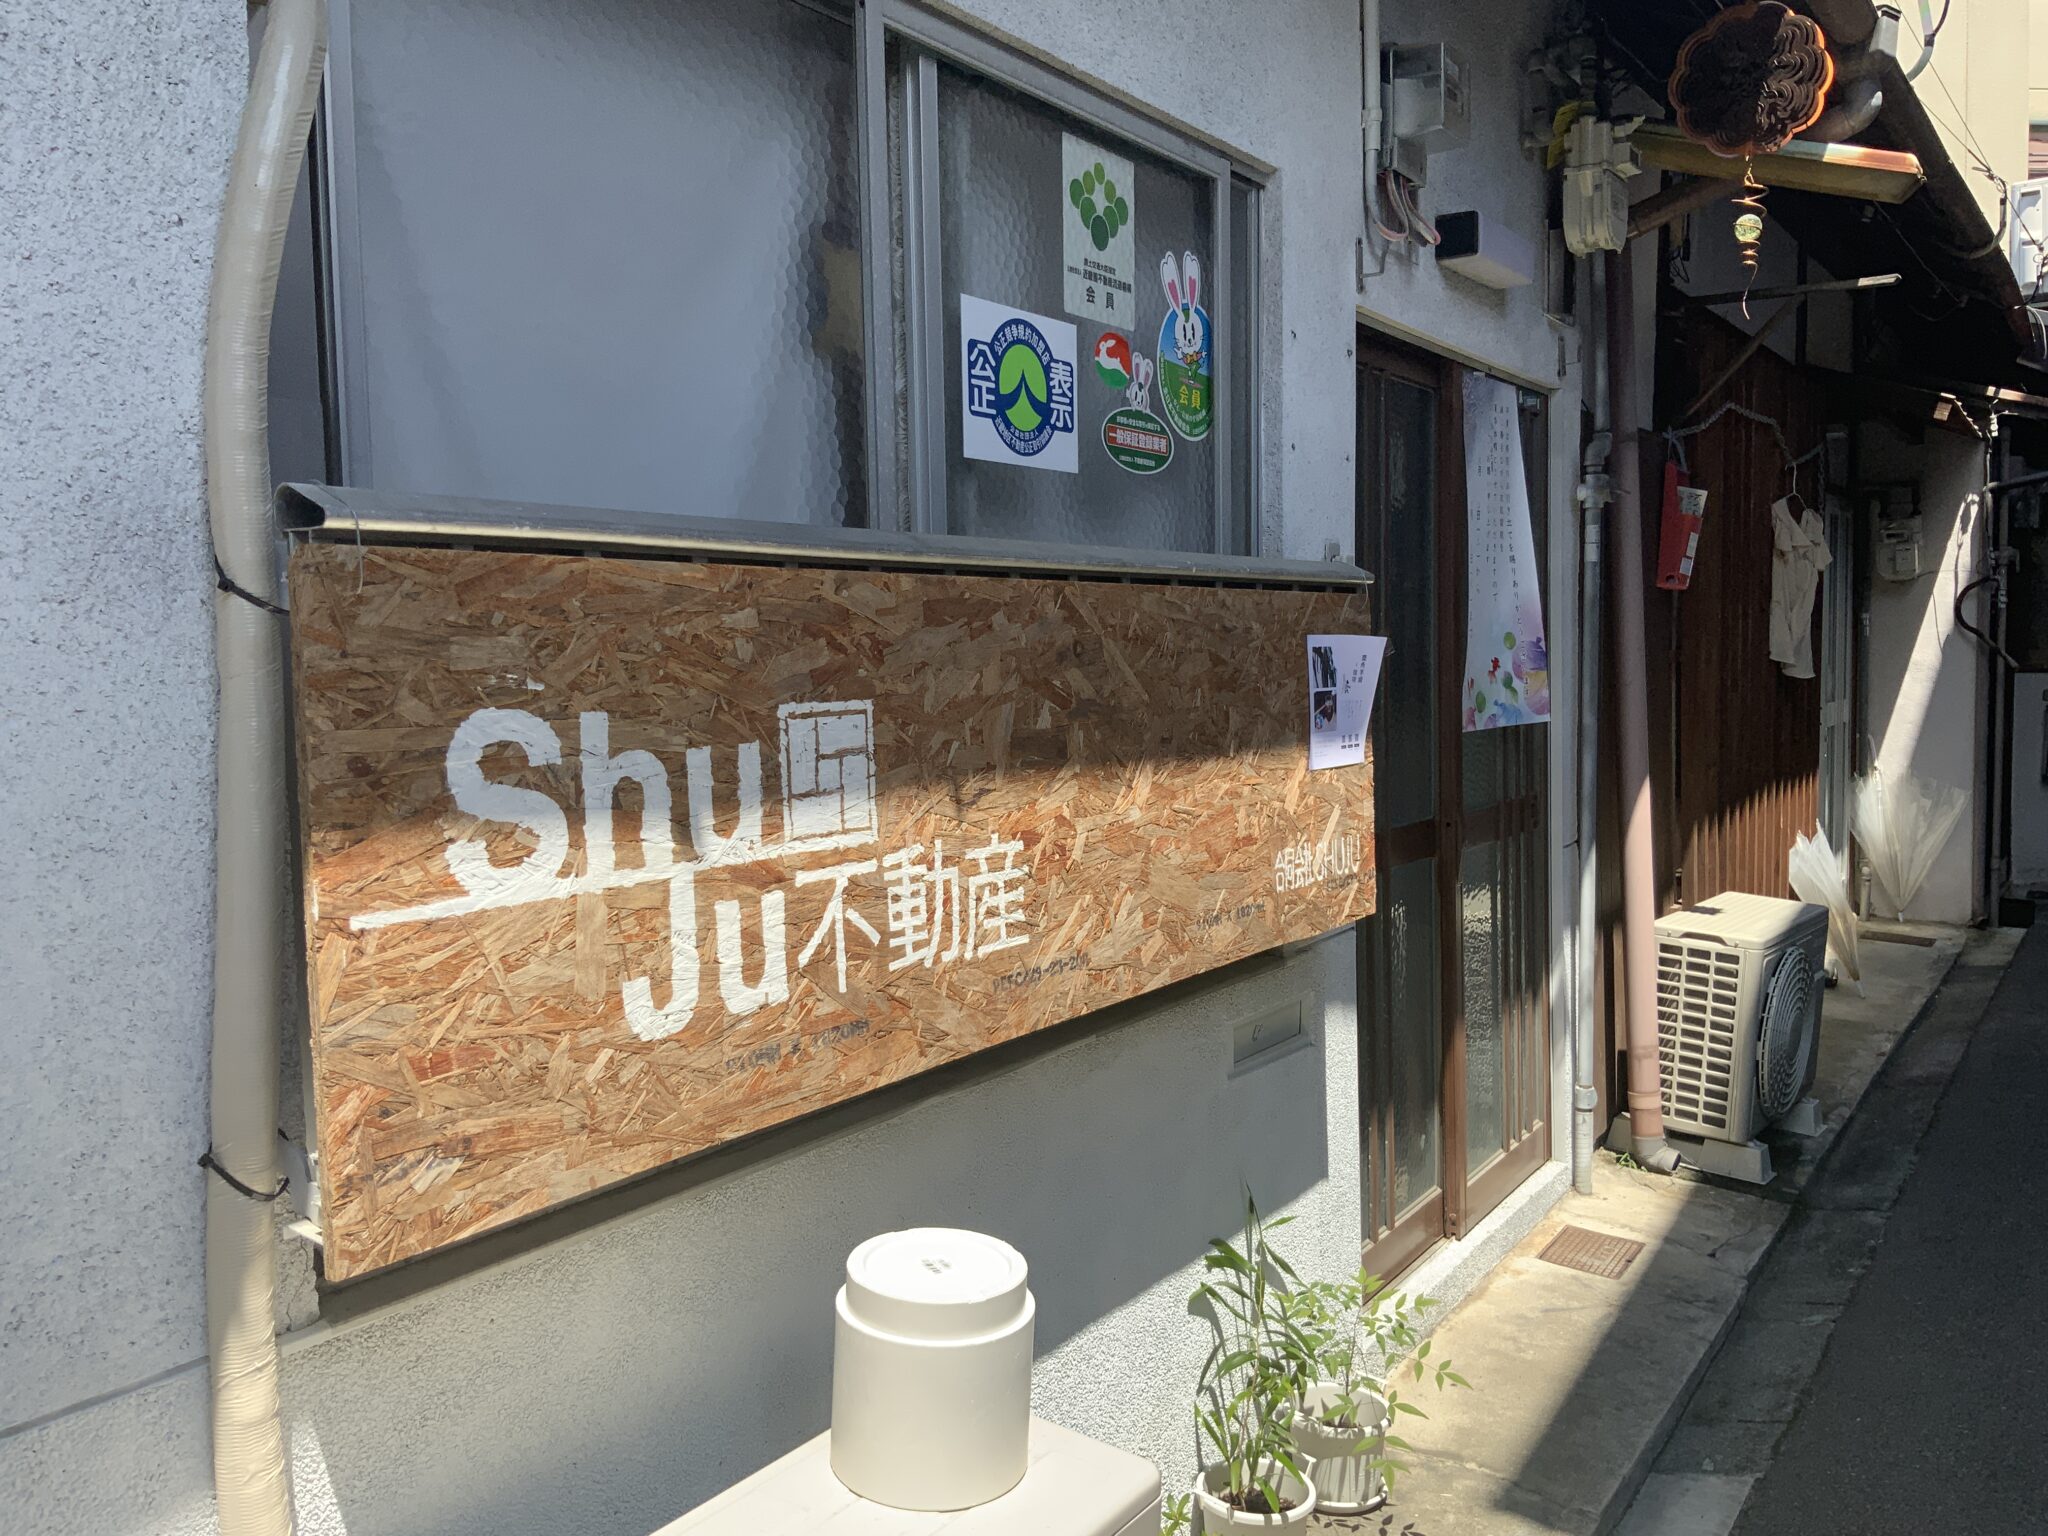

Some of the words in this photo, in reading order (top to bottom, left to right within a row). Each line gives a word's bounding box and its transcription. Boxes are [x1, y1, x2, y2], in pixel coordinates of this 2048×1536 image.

[969, 343, 997, 415] 公正
[1049, 361, 1073, 429] 表示
[1179, 384, 1201, 410] 会員
[795, 833, 1032, 994] 不動産
